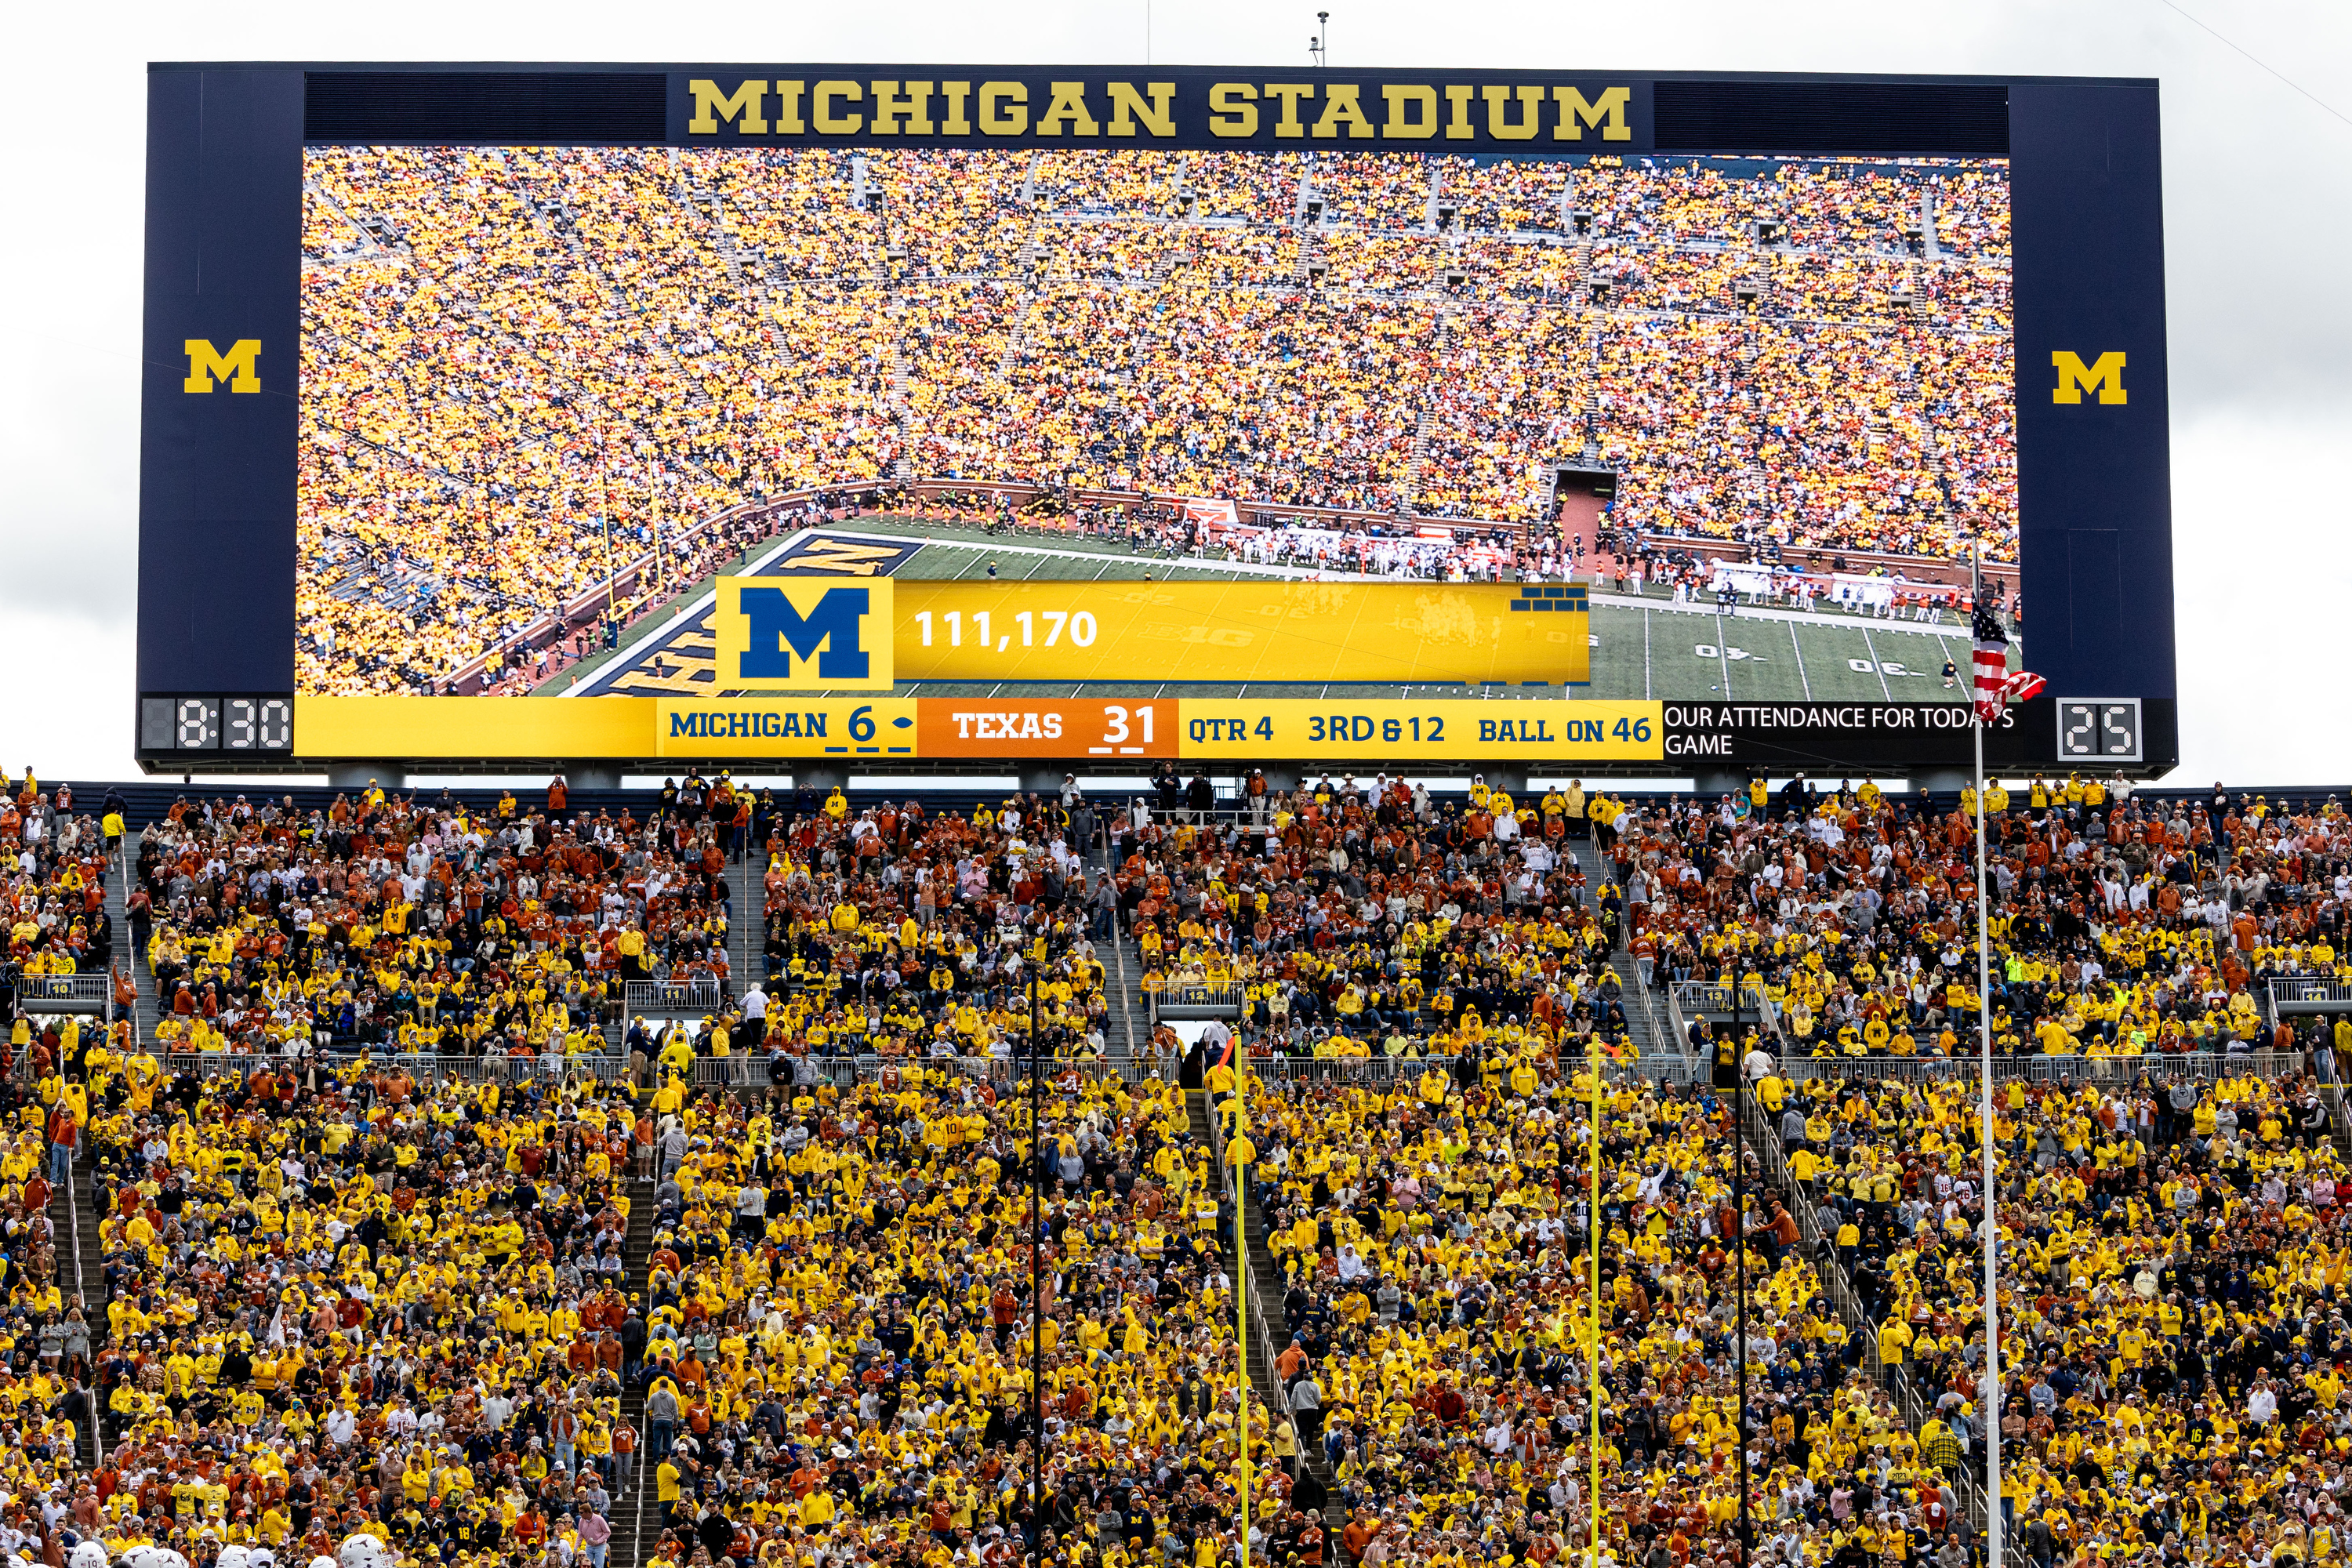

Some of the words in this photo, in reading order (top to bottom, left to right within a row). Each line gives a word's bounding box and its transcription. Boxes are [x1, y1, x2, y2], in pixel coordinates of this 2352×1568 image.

[688, 79, 1176, 136] MICHIGAN
[1208, 82, 1631, 141] STADIUM
[184, 339, 261, 394] M
[2052, 350, 2127, 405] M
[740, 586, 869, 679] M
[915, 611, 1098, 652] 111,170
[1664, 706, 1712, 728] OUR
[1719, 706, 1866, 728] ATTENDANCE
[1873, 707, 1915, 728] FOR
[1920, 707, 2014, 728] TODAS
[179, 699, 289, 748] 8:30
[670, 712, 828, 738] MICHIGAN
[848, 706, 877, 742] 6
[952, 713, 1062, 739] TEXAS
[1102, 706, 1153, 743] 31
[1308, 715, 1375, 742] 3RD
[1382, 719, 1402, 742] &
[1408, 717, 1445, 742] 12
[1189, 718, 1247, 743] QTR
[1254, 716, 1274, 741] 4
[1479, 719, 1555, 742] BALL
[1566, 720, 1604, 742] ON
[1612, 717, 1652, 742] 46
[2067, 706, 2132, 753] 25
[1665, 735, 1732, 755] GAME
[2038, 787, 2041, 796] 1
[1724, 810, 1730, 818] 7
[1232, 898, 1236, 906] 1
[1996, 923, 1999, 932] 1
[2040, 924, 2045, 932] 2
[1022, 949, 1033, 959] 16
[53, 985, 68, 993] 10
[666, 990, 679, 999] 11
[1189, 991, 1204, 1000] 12
[1708, 992, 1722, 1000] 13
[935, 1075, 942, 1083] 2
[50, 1083, 53, 1093] 1
[946, 1123, 956, 1134] 10
[1941, 1184, 1949, 1192] 16
[470, 1196, 477, 1204] 2
[1959, 1189, 1970, 1200] 16
[1577, 1205, 1586, 1216] 10
[2085, 1218, 2093, 1228] 2
[1887, 1226, 1894, 1238] 2
[1901, 1309, 1905, 1320] 1
[1881, 1333, 1885, 1346] 1
[988, 1372, 993, 1383] 4
[1491, 1430, 1504, 1439] TEXAS
[2191, 1428, 2202, 1443] 16
[956, 1498, 967, 1507] M
[458, 1527, 470, 1540] 18
[1907, 1536, 1915, 1547] 2
